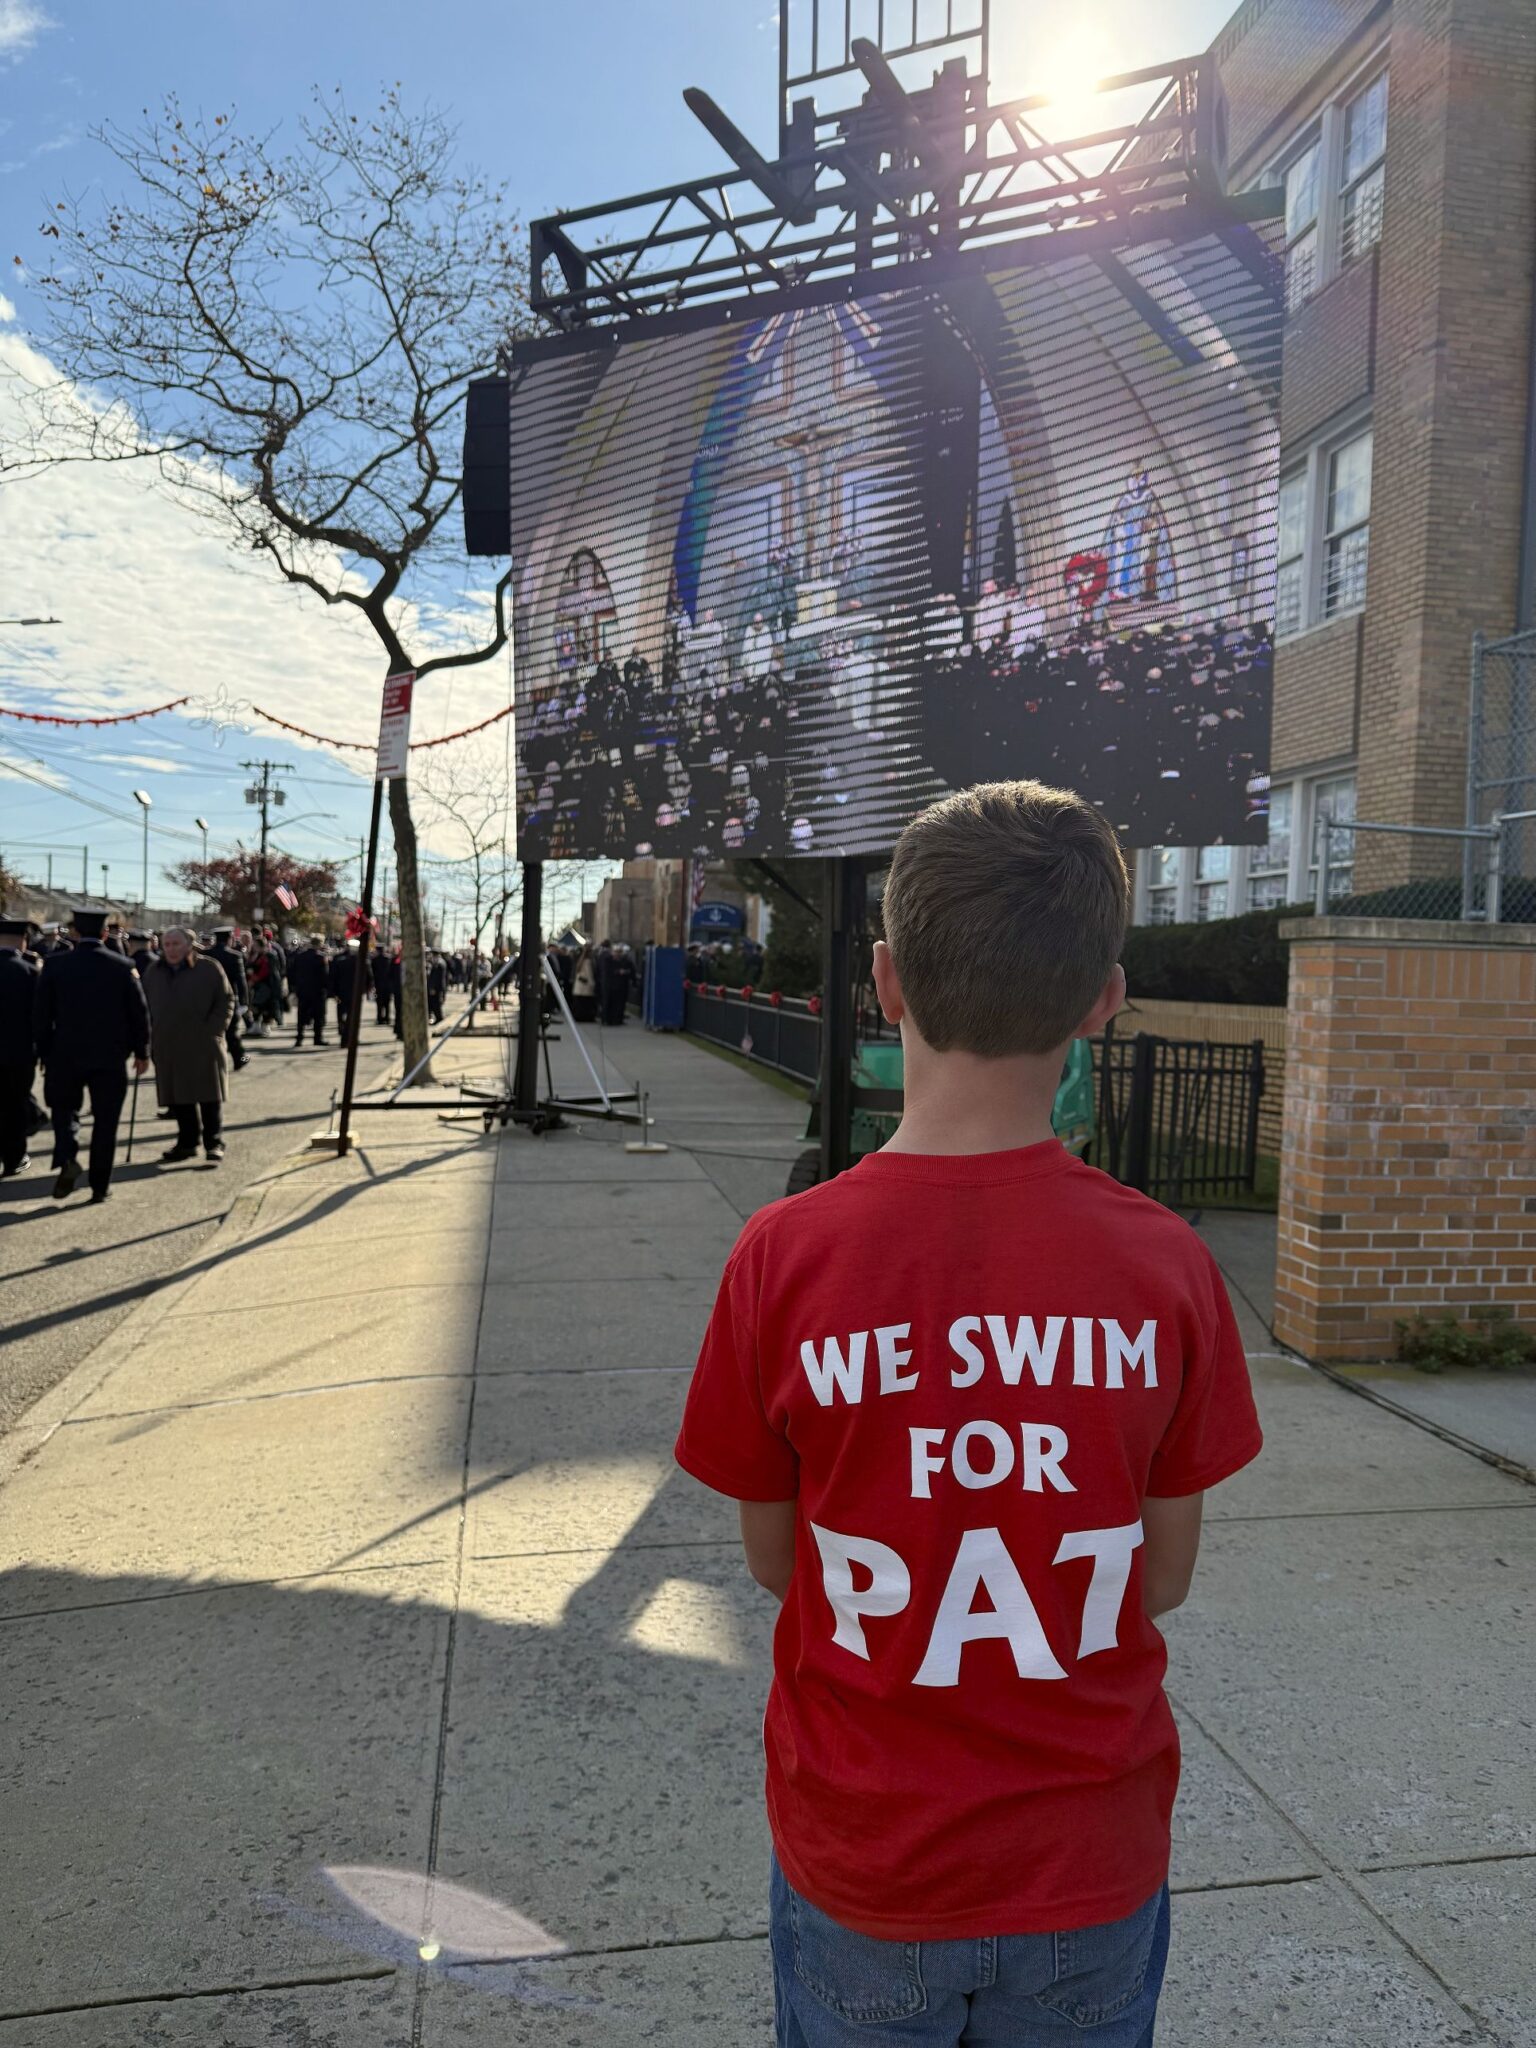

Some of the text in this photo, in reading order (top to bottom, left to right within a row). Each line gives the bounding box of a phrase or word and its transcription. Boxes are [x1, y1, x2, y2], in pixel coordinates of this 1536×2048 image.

[800, 1315, 1159, 1407] WE SWIM
[908, 1419, 1078, 1499] FOR
[809, 1516, 1145, 1687] PAT
